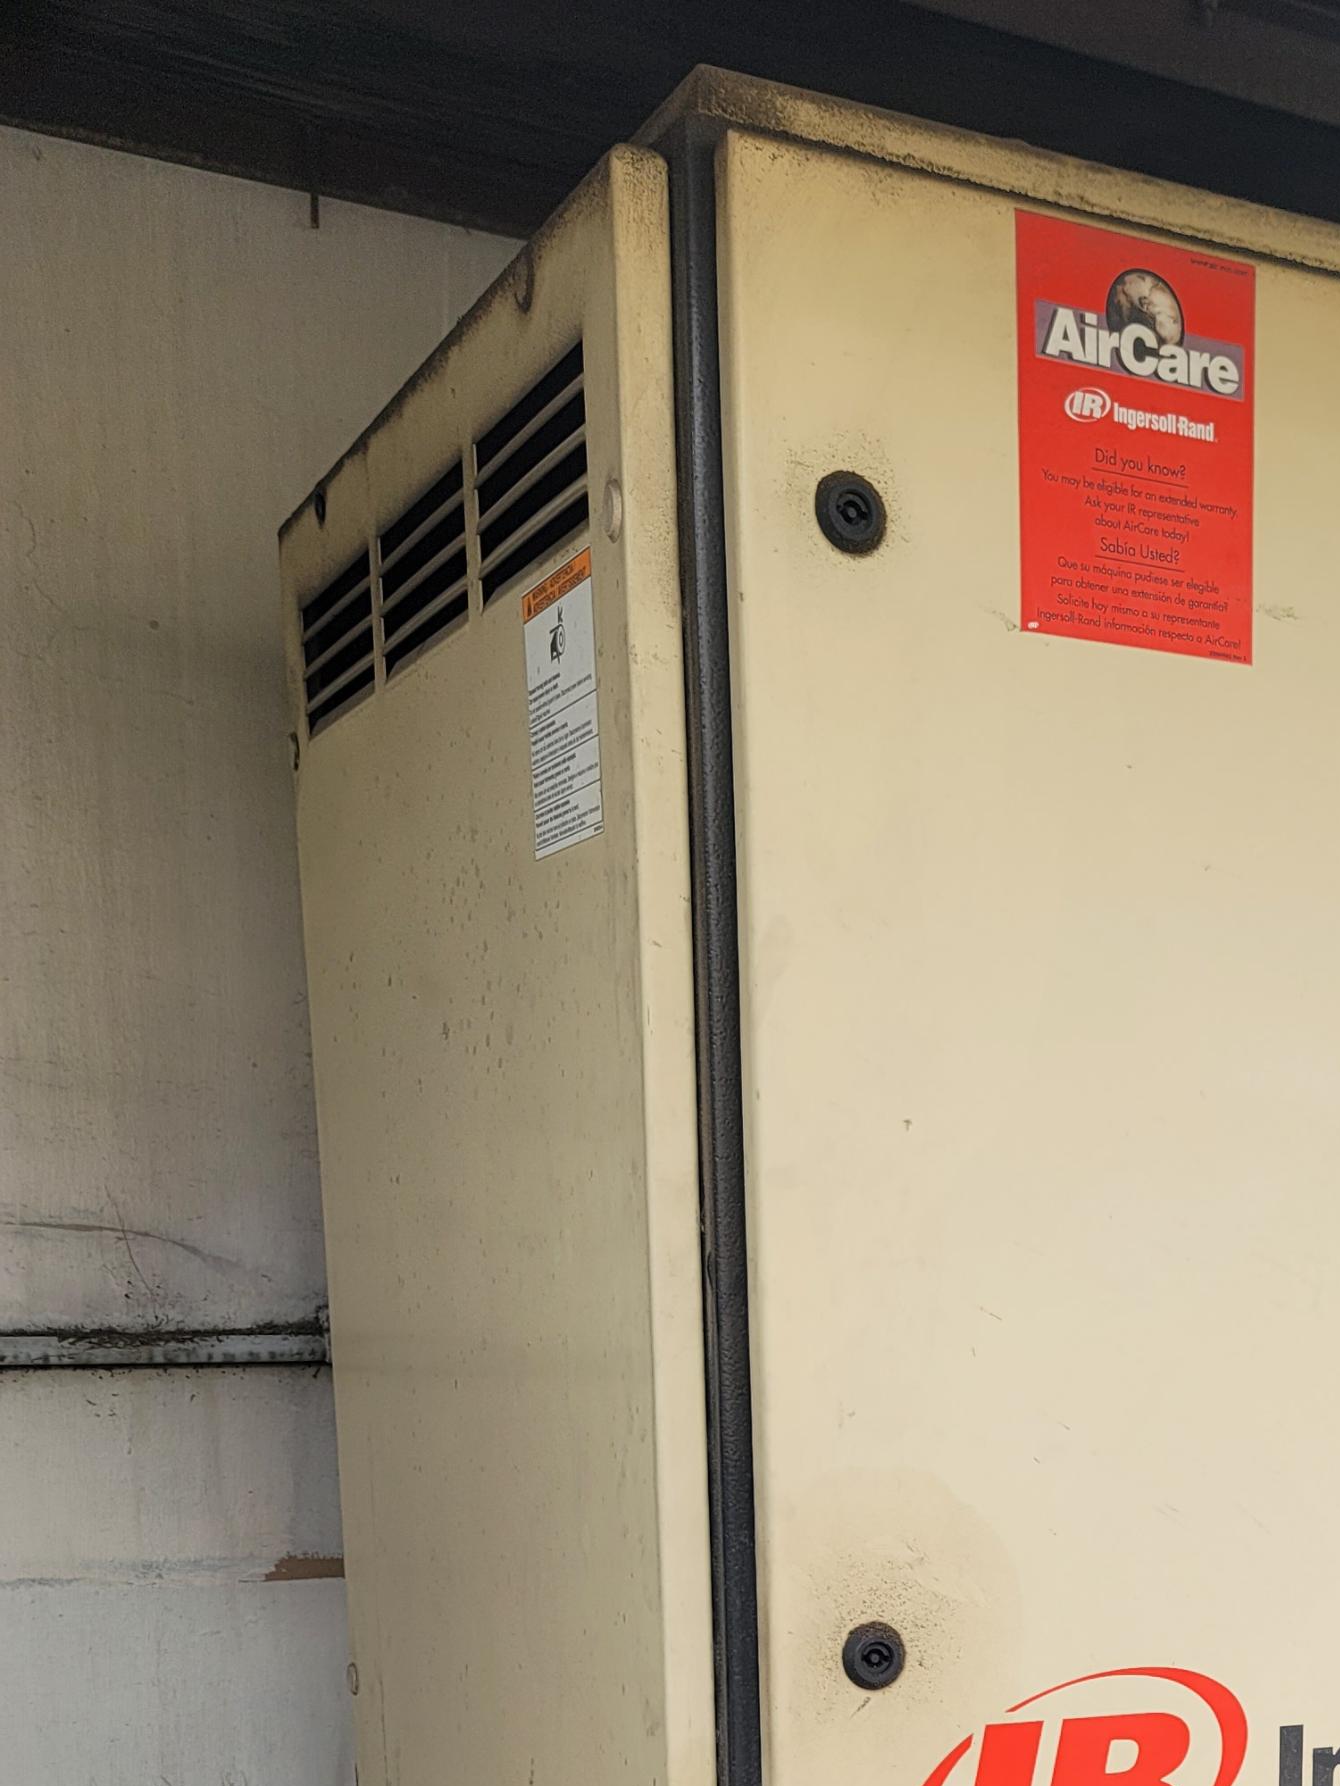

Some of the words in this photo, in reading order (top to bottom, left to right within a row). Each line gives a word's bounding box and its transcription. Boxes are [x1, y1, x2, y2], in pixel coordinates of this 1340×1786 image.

[1045, 307, 1239, 395] AirCare
[1095, 448, 1117, 466] Did
[1120, 454, 1143, 472] you
[1147, 457, 1186, 480] know?
[1042, 469, 1059, 483] You
[1061, 474, 1081, 489] may
[1083, 474, 1095, 490] be
[1096, 478, 1128, 498] eligible
[1130, 483, 1143, 498] for
[1146, 490, 1156, 501] an
[1159, 492, 1197, 510] extended
[1084, 495, 1101, 508] Ask
[1104, 501, 1124, 514] your
[1127, 501, 1136, 513] IR
[1138, 506, 1200, 527] representative
[1095, 515, 1120, 530] about
[1123, 519, 1159, 537] AirCare
[1161, 527, 1189, 543] today!
[1100, 537, 1136, 556] Sabía
[1140, 546, 1180, 565] Usted?
[1051, 574, 1072, 588] para
[1076, 578, 1109, 593] obtener
[1112, 586, 1129, 596] una
[1131, 587, 1171, 605] extensión
[1174, 592, 1186, 606] de
[1057, 556, 1078, 570] Que
[1080, 562, 1090, 572] su
[1093, 563, 1132, 583] máquina
[1134, 570, 1168, 587] pudiese
[1171, 576, 1184, 588] ser
[1186, 578, 1220, 595] elegible
[1037, 608, 1101, 628] Ingersoll-Rand
[1104, 616, 1156, 636] información
[1057, 593, 1090, 608] Solicite
[1092, 598, 1108, 613] hoy
[1112, 602, 1140, 618] mismo
[1150, 611, 1160, 622] su
[1162, 612, 1220, 630] representante
